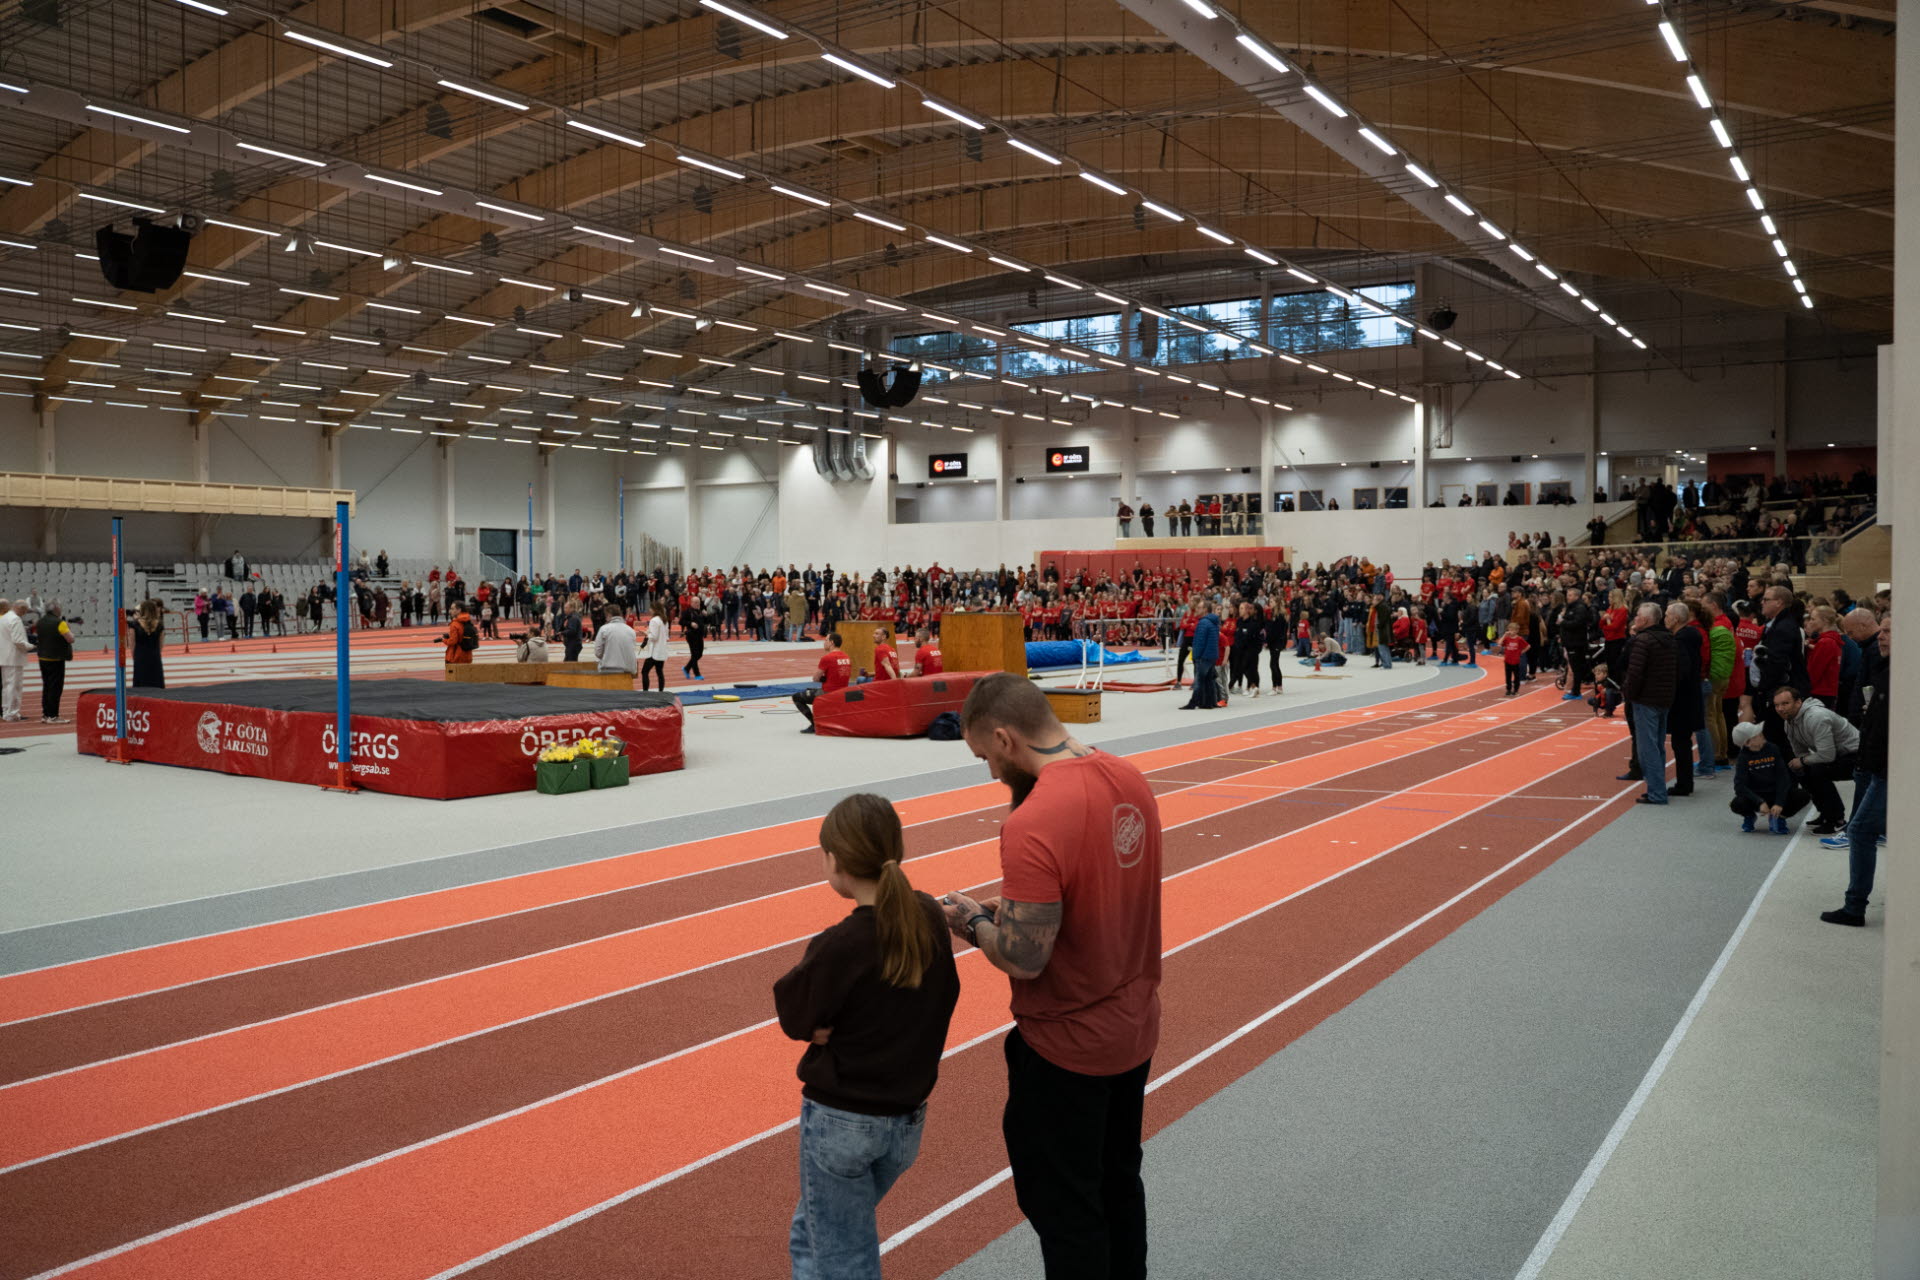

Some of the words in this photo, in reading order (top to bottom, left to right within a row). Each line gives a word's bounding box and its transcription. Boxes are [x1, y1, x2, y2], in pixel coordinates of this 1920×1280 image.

[96, 703, 151, 733] ÖBRGS
[237, 722, 268, 743] GÖTA
[322, 724, 400, 760] ÖERGS
